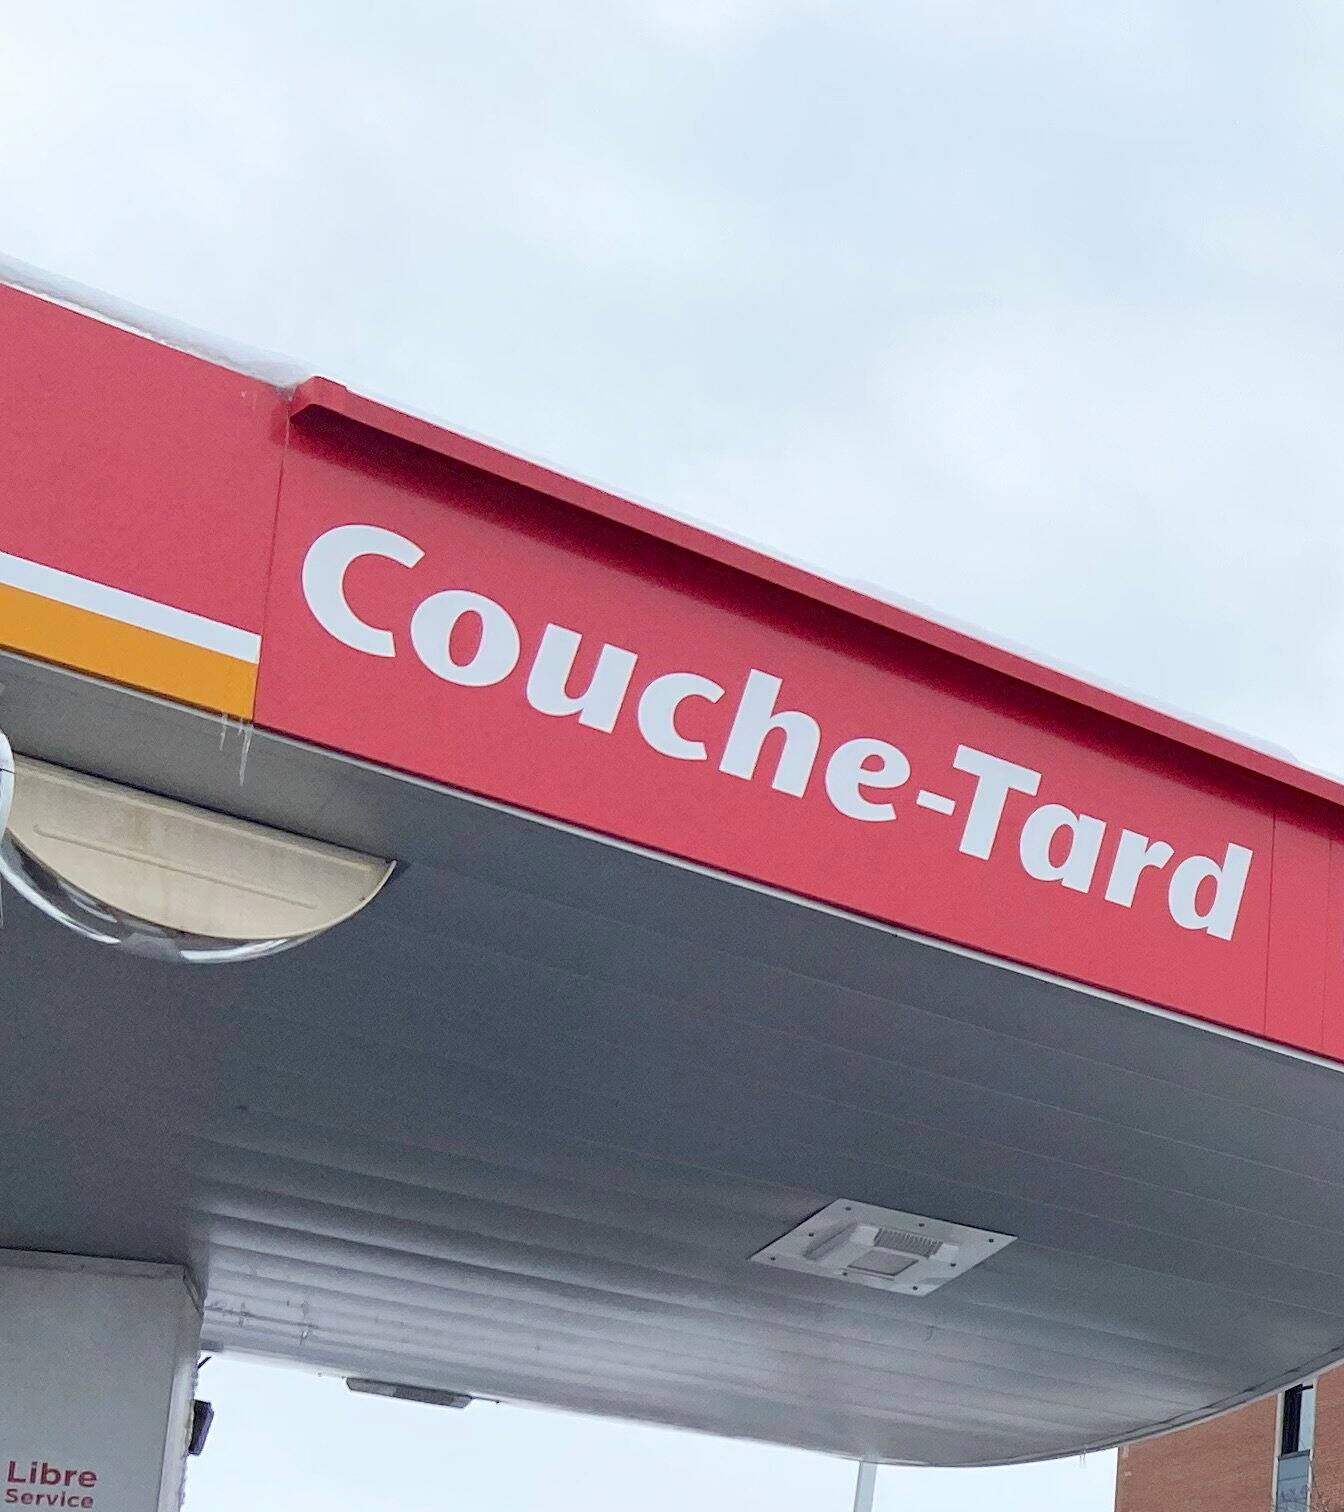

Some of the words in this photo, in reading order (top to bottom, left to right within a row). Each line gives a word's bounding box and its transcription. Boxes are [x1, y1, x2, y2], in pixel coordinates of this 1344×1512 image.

[301, 522, 1254, 943] Couche-Tard
[7, 1460, 97, 1487] Libre
[5, 1488, 94, 1509] Service
